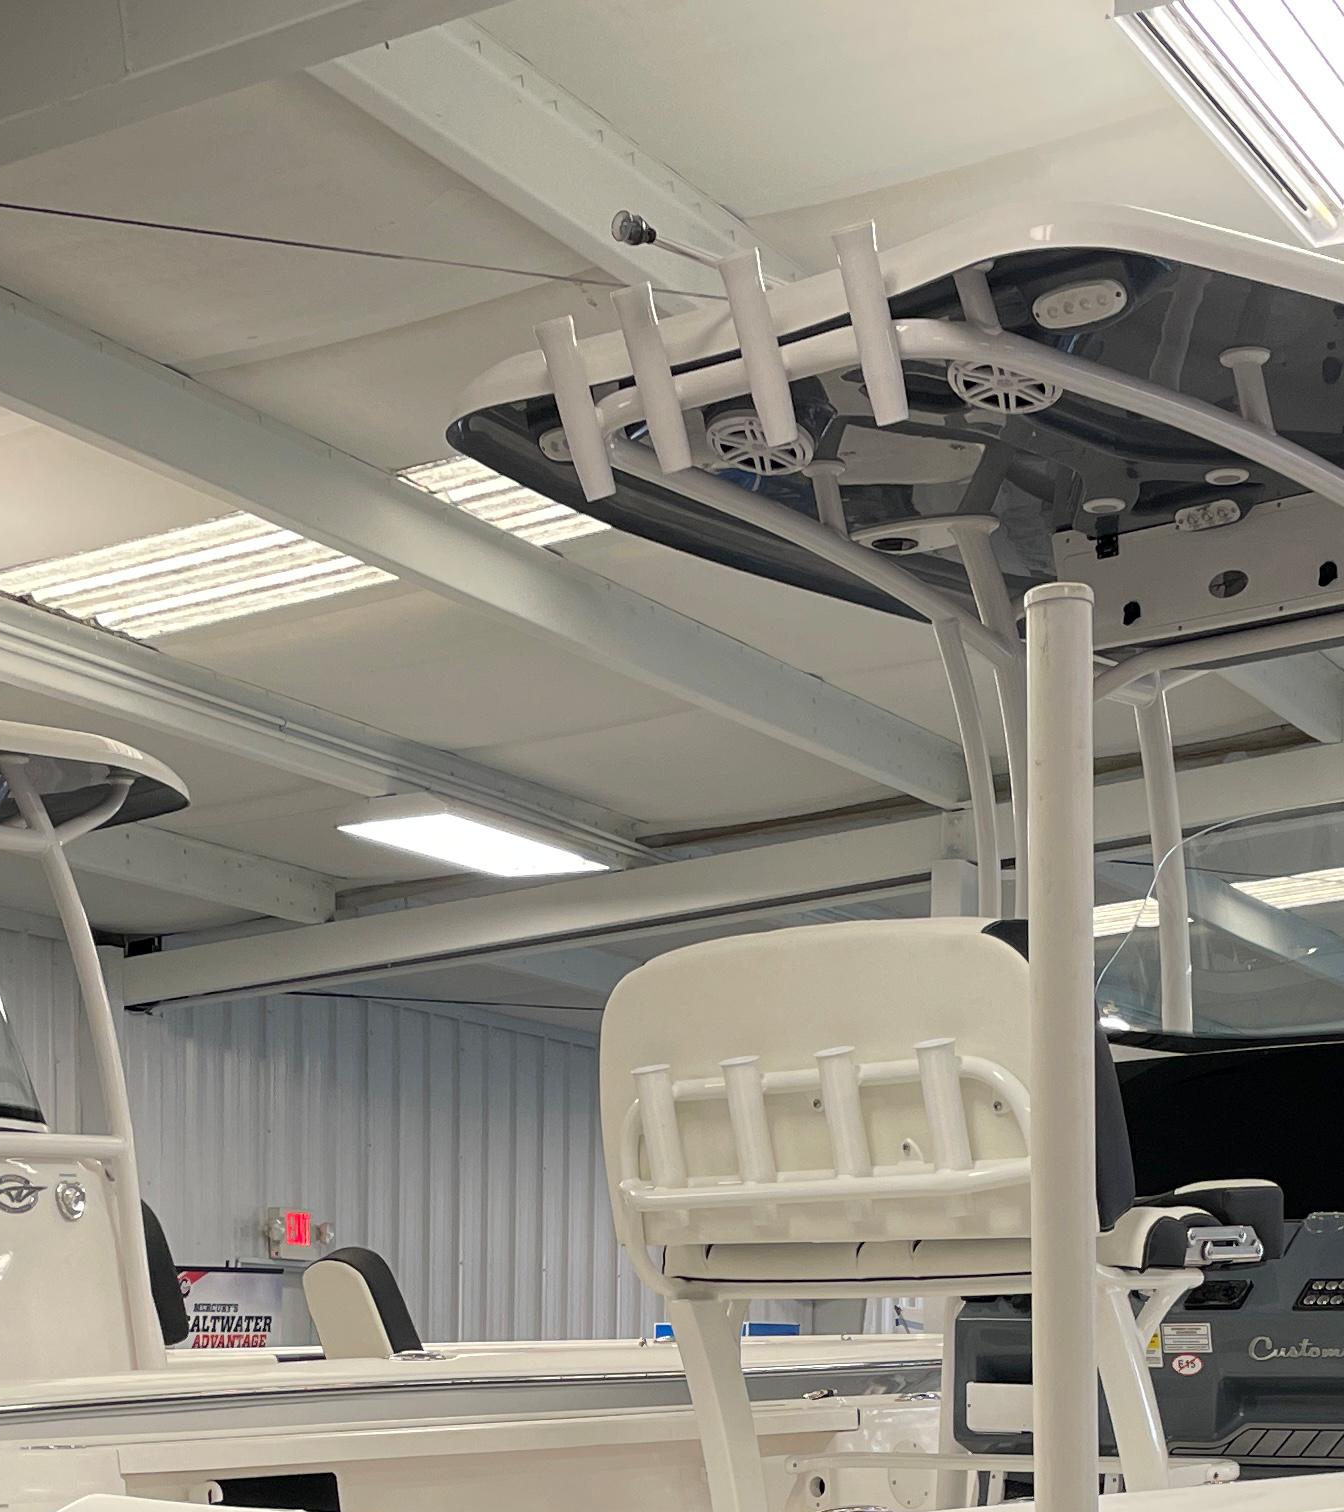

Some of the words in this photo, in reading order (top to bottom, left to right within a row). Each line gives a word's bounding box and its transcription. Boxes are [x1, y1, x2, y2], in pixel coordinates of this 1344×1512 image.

[193, 1303, 239, 1313] MERCURY'S
[187, 1315, 273, 1333] ALTWATER
[192, 1334, 267, 1349] ADVANTAGE
